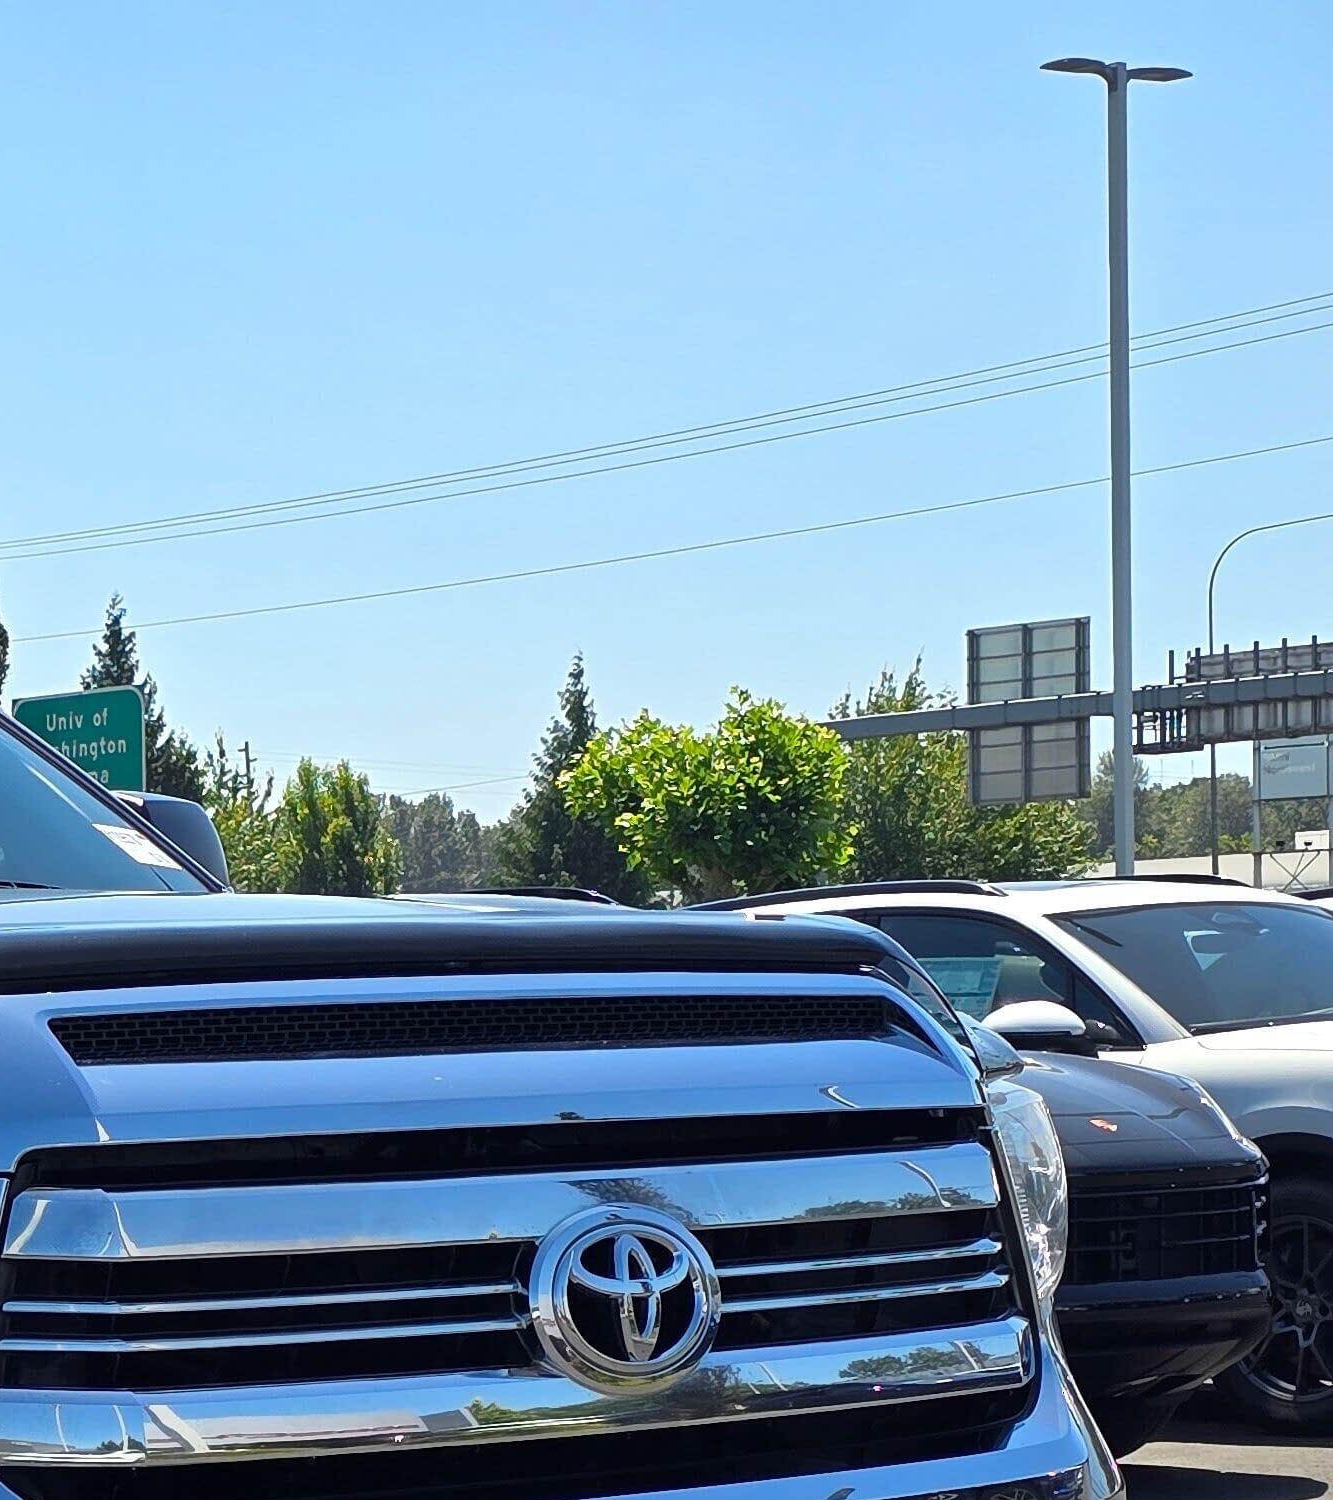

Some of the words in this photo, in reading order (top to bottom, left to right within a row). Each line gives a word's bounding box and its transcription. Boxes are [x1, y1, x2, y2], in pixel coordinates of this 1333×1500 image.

[46, 711, 83, 732] Univ
[93, 707, 108, 726] of
[54, 737, 126, 761] hington
